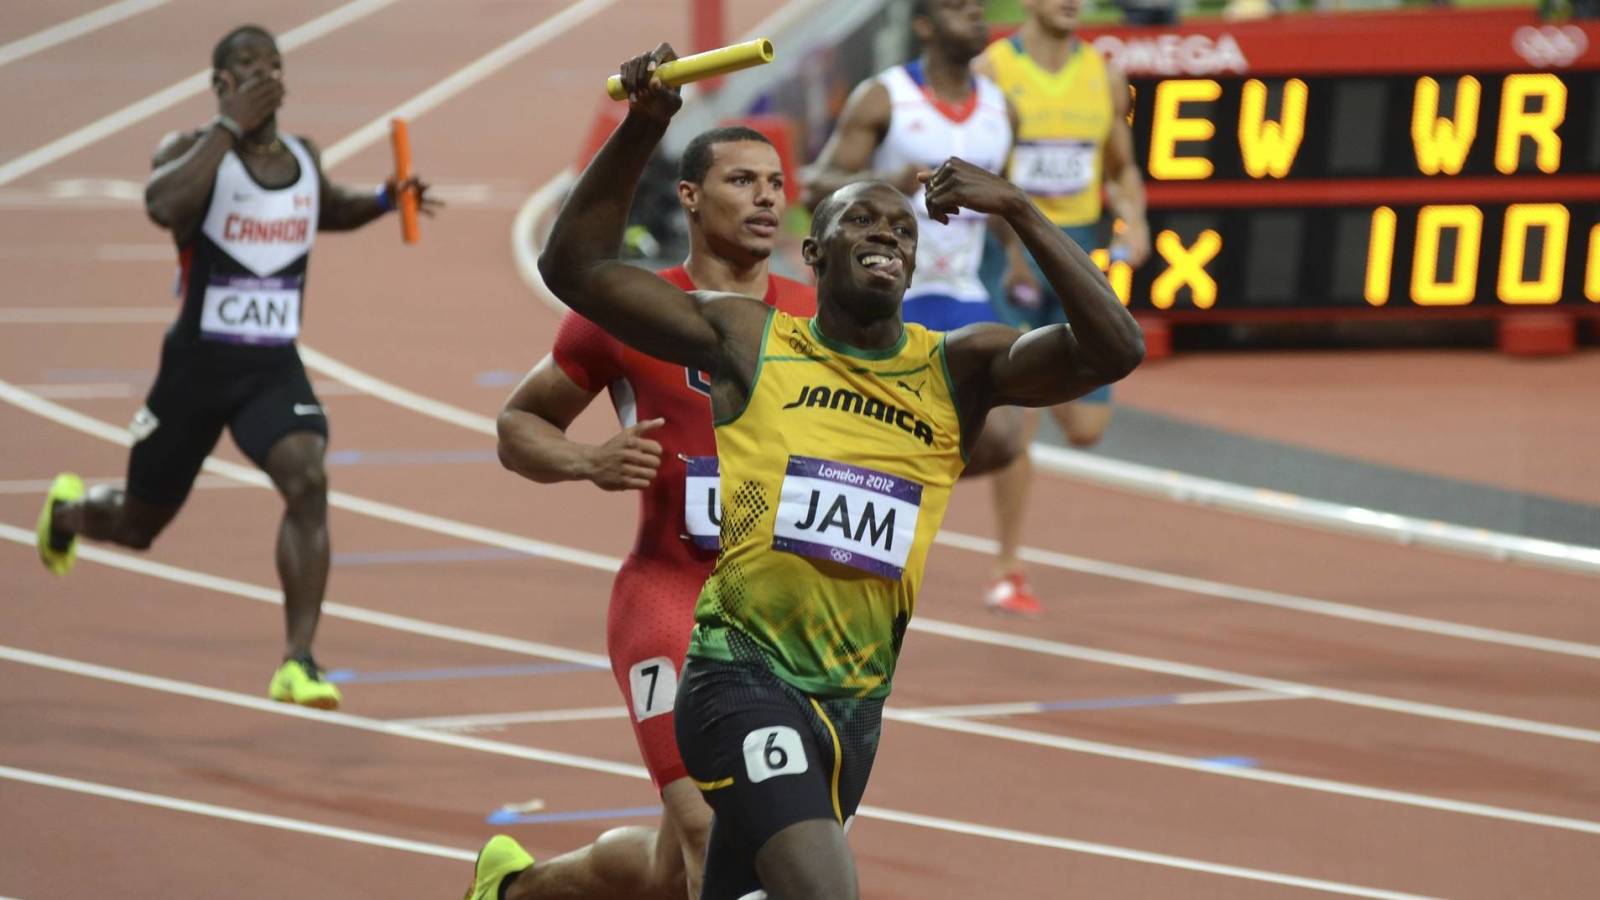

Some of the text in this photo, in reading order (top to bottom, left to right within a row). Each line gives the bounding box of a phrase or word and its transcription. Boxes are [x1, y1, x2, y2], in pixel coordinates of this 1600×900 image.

[1092, 33, 1249, 75] OMEGA
[1127, 73, 1568, 180] EW WR
[224, 212, 309, 243] CANADA
[1364, 203, 1600, 305] 100
[218, 296, 288, 327] CAN
[782, 385, 935, 446] JAMAICA
[818, 463, 895, 494] London 2012
[794, 489, 897, 552] JAM
[640, 664, 660, 712] 7
[764, 732, 788, 770] 6
